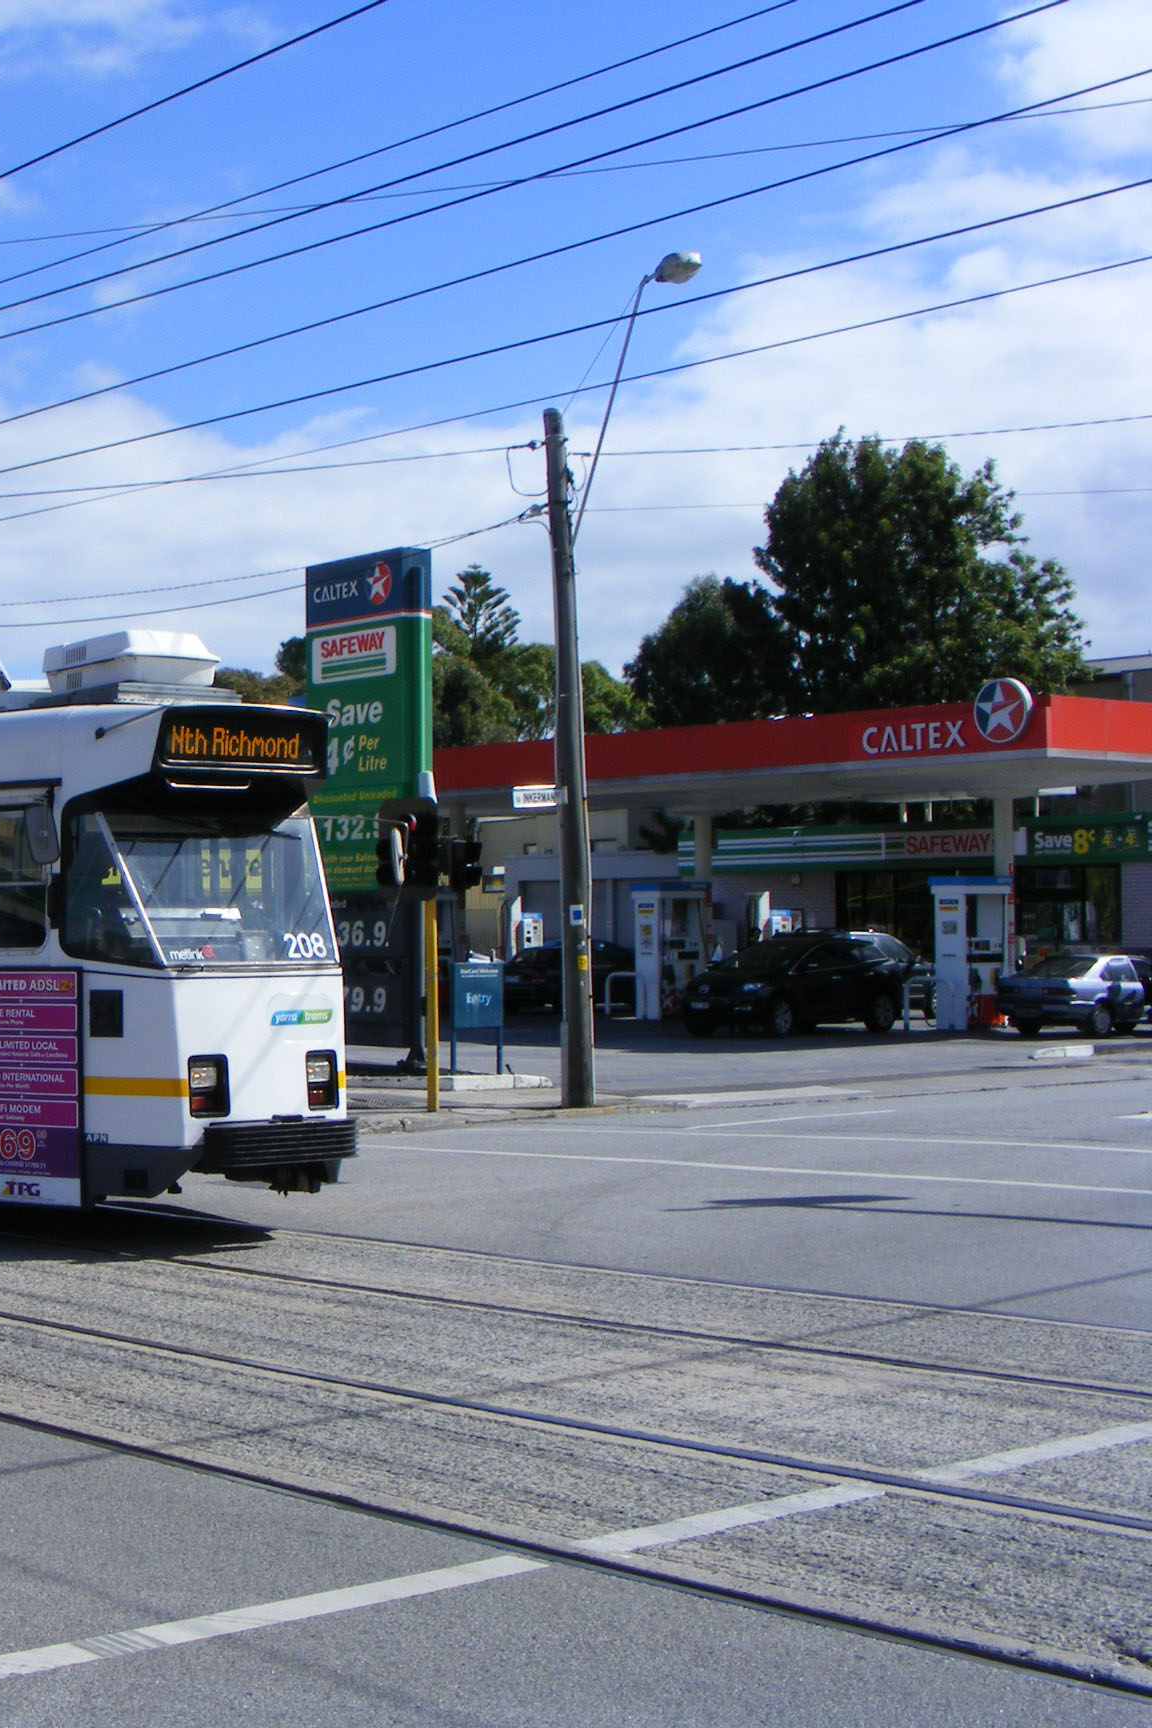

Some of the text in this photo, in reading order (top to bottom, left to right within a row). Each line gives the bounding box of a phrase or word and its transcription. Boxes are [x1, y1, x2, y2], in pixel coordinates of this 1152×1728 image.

[313, 580, 358, 603] CALTEX
[320, 631, 385, 658] SAFEWAY
[327, 699, 383, 728] Save
[171, 725, 300, 758] Nth Richmond
[358, 735, 380, 752] Per
[862, 720, 966, 755] CALTEX
[358, 755, 387, 772] Litre
[906, 833, 991, 855] SAFEWAY
[1034, 831, 1072, 849] Save
[338, 920, 386, 947] 36.9
[284, 932, 328, 958] 208
[466, 992, 492, 1006] Entry
[6, 1009, 36, 1018] RENTAL
[274, 1010, 328, 1024] yarra trams
[31, 1041, 58, 1050] LOCAL
[2, 1073, 65, 1083] INTERNATIONAL
[9, 1104, 42, 1114] MODEM
[86, 1134, 106, 1142] APN
[5, 1180, 40, 1197] TPG
